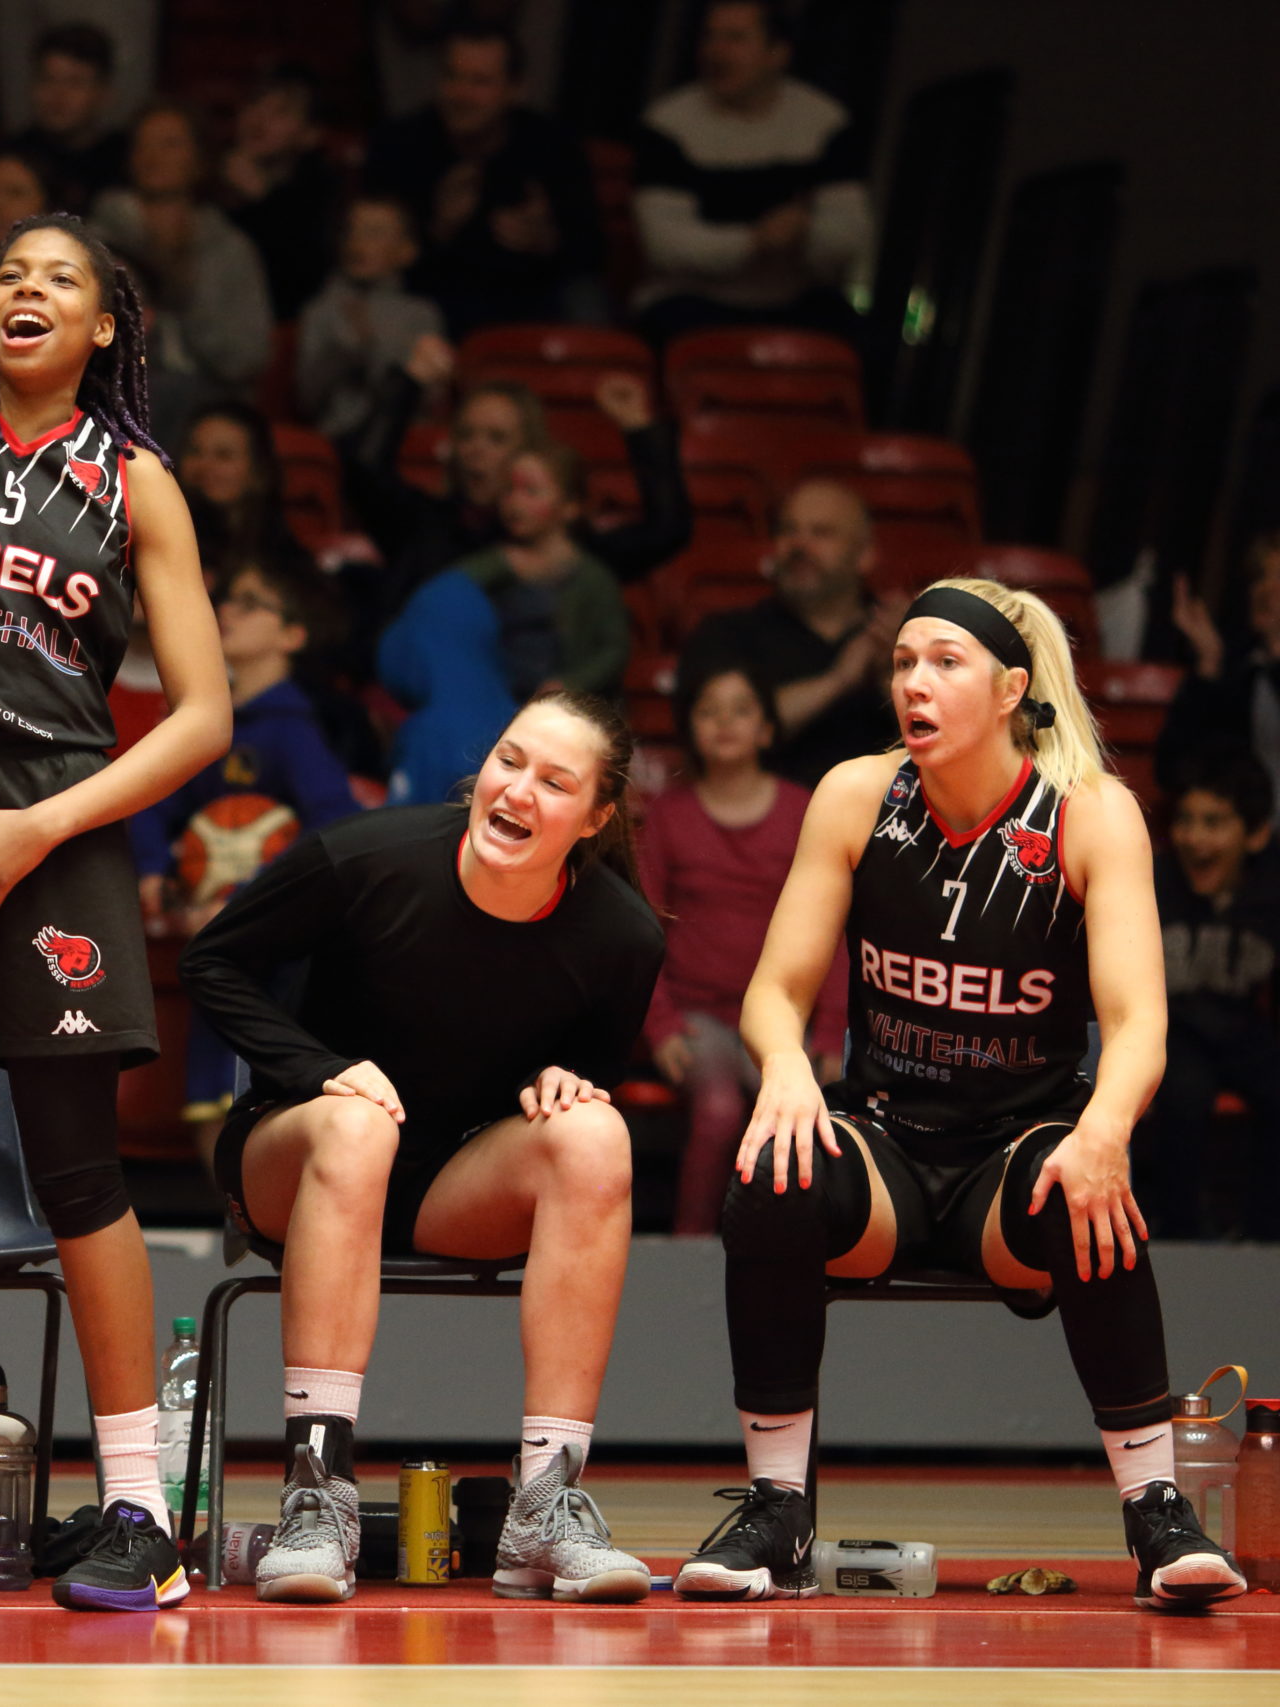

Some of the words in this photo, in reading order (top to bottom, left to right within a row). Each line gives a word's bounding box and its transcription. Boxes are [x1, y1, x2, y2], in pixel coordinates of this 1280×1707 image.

[3, 710, 16, 723] of
[940, 879, 968, 942] 7
[47, 957, 69, 986] ESSEX
[860, 938, 1056, 1015] REBELS
[227, 1530, 244, 1570] evian
